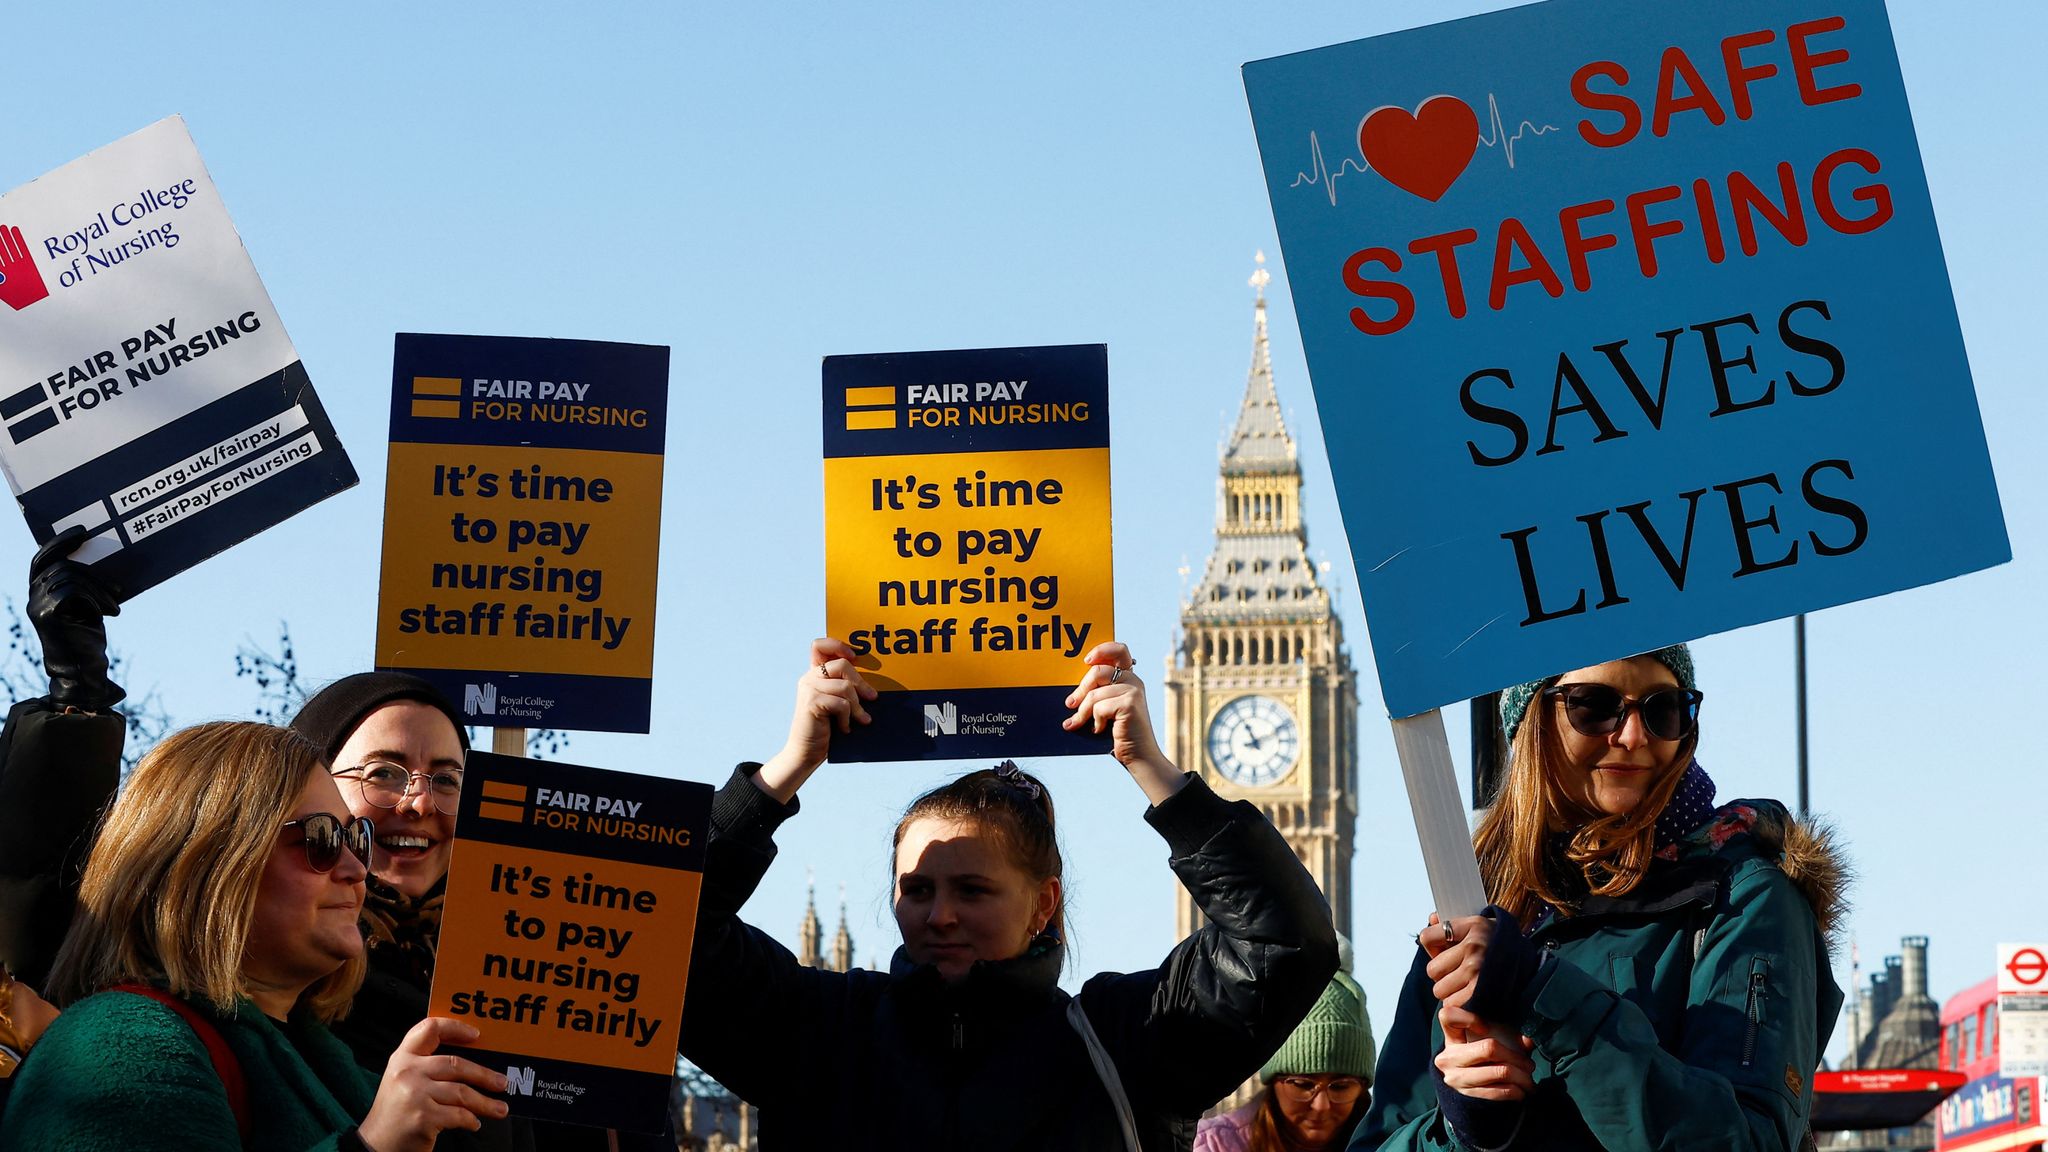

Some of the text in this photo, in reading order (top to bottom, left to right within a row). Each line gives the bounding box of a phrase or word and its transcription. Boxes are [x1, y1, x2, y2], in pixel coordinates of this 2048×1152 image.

[1570, 16, 1862, 148] SAFE
[43, 176, 197, 260] Royal College
[59, 221, 180, 289] of Nursing
[1341, 148, 1894, 337] STAFFING
[47, 318, 177, 395] FAIR PAY
[60, 310, 261, 420] FOR NURSING
[473, 379, 590, 401] FAIR PAY
[907, 381, 1028, 404] FAIR PAY
[1459, 299, 1846, 467] SAVES
[471, 402, 648, 427] FOR NURSING
[908, 402, 1089, 428] FOR NURSING
[120, 421, 281, 508] rcn.org.uk/fairpay
[433, 465, 613, 502] It's time
[133, 440, 312, 535] #FairPayForNursing
[872, 471, 1063, 511] It's time
[451, 513, 590, 554] to pay
[894, 527, 1042, 564] to pay
[1500, 459, 1868, 628] LIVES
[432, 556, 602, 601] nursing
[878, 567, 1059, 610] nursing
[399, 603, 631, 649] staff fairly
[849, 616, 1092, 657] staff fairly
[500, 696, 555, 709] Royal College
[500, 706, 542, 720] of Nursing
[961, 712, 1017, 726] Royal College
[961, 723, 1005, 736] of Nursing
[536, 788, 642, 818] FAIR PAY
[533, 810, 691, 846] FOR NURSING
[490, 864, 657, 913] It's time
[504, 910, 633, 959] to pay
[483, 953, 640, 1002] nursing
[450, 990, 662, 1048] staff fairly
[536, 1090, 574, 1104] of Nursing
[538, 1080, 586, 1095] Royal College
